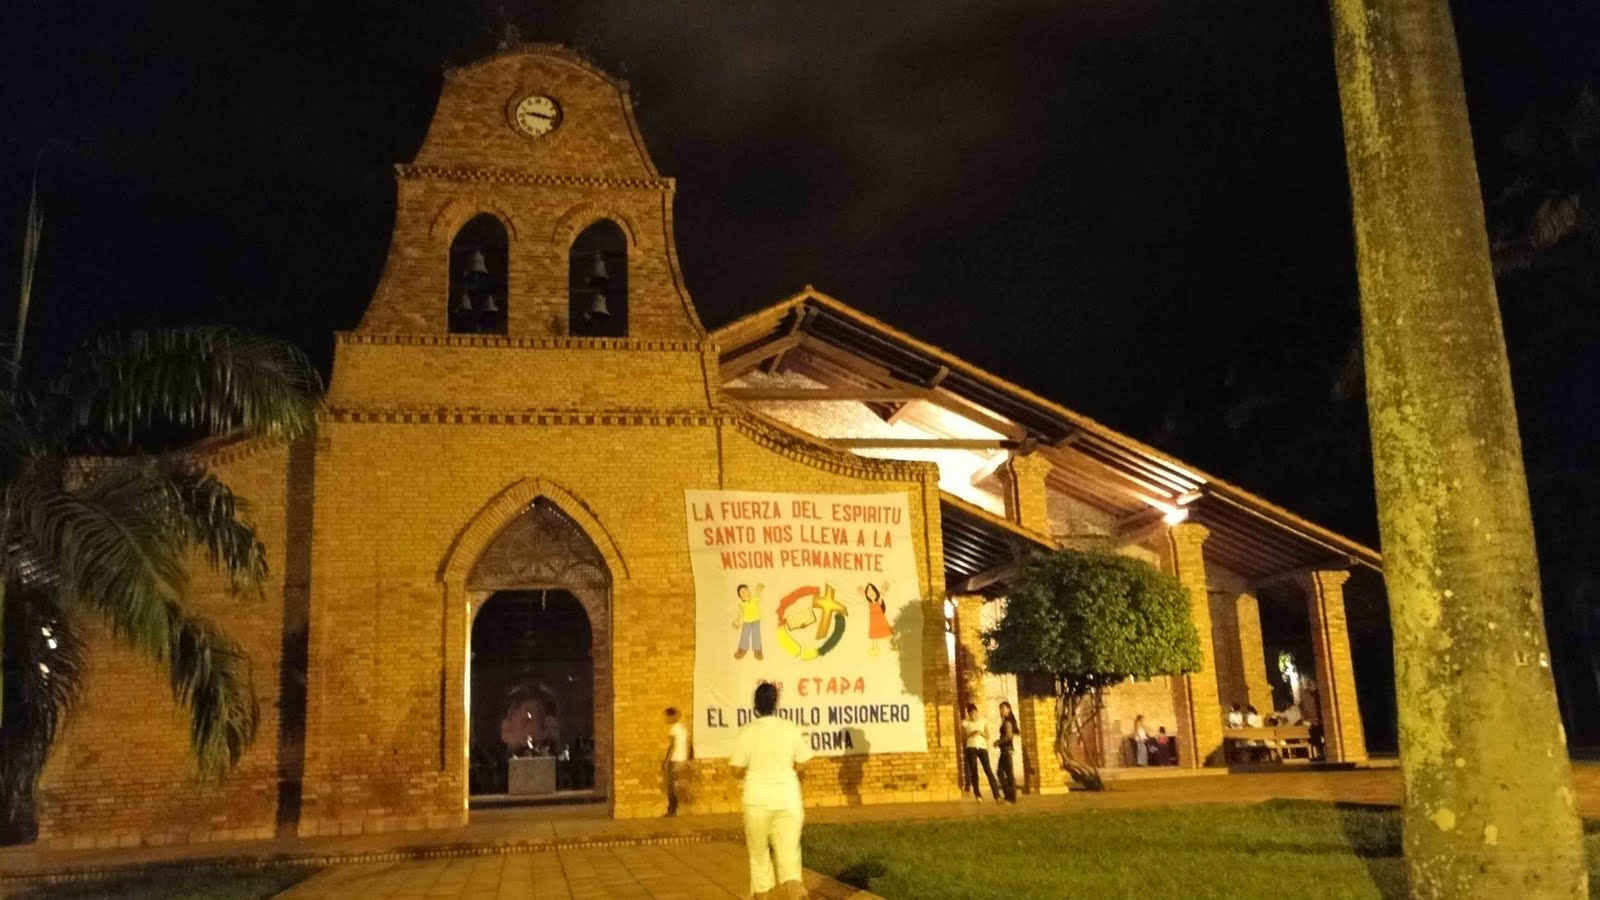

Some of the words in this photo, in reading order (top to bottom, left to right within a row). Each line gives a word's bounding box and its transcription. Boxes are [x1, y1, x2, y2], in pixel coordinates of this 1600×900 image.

[692, 502, 715, 521] LA
[720, 501, 781, 520] FUERZA
[792, 501, 822, 519] DEL
[832, 504, 901, 524] ESPIRITU
[704, 526, 755, 546] SANTO
[763, 525, 793, 544] NOS
[800, 525, 848, 545] LLEVA
[856, 530, 865, 546] A
[873, 530, 892, 548] LA
[721, 551, 774, 570] MISION
[780, 549, 884, 572] PERMANENTE
[797, 676, 865, 697] ETAPA
[707, 708, 728, 728] EL
[828, 704, 910, 725] MISIONERO
